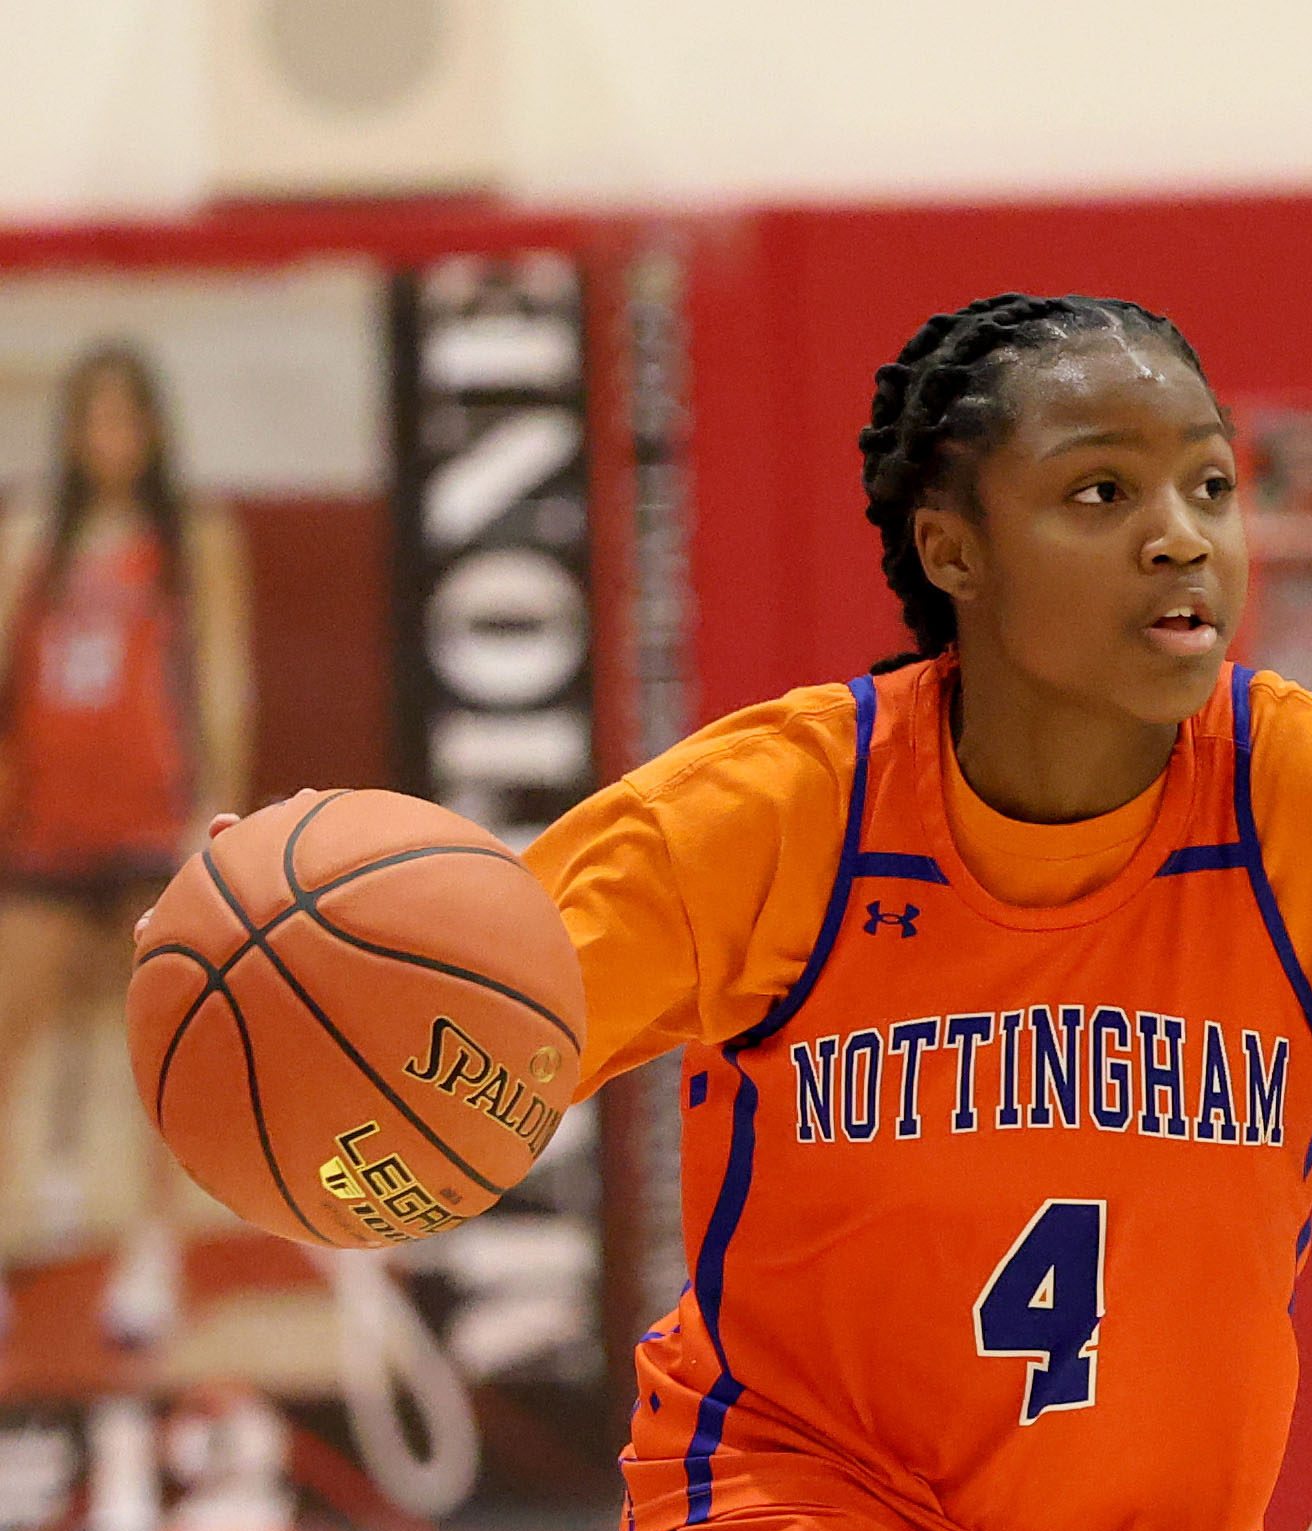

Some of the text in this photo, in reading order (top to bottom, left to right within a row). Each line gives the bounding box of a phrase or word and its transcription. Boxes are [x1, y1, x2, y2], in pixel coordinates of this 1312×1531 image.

[402, 1016, 562, 1158] SPALDIN
[791, 1004, 1289, 1146] NOTTINGHAM
[972, 1198, 1107, 1426] 4
